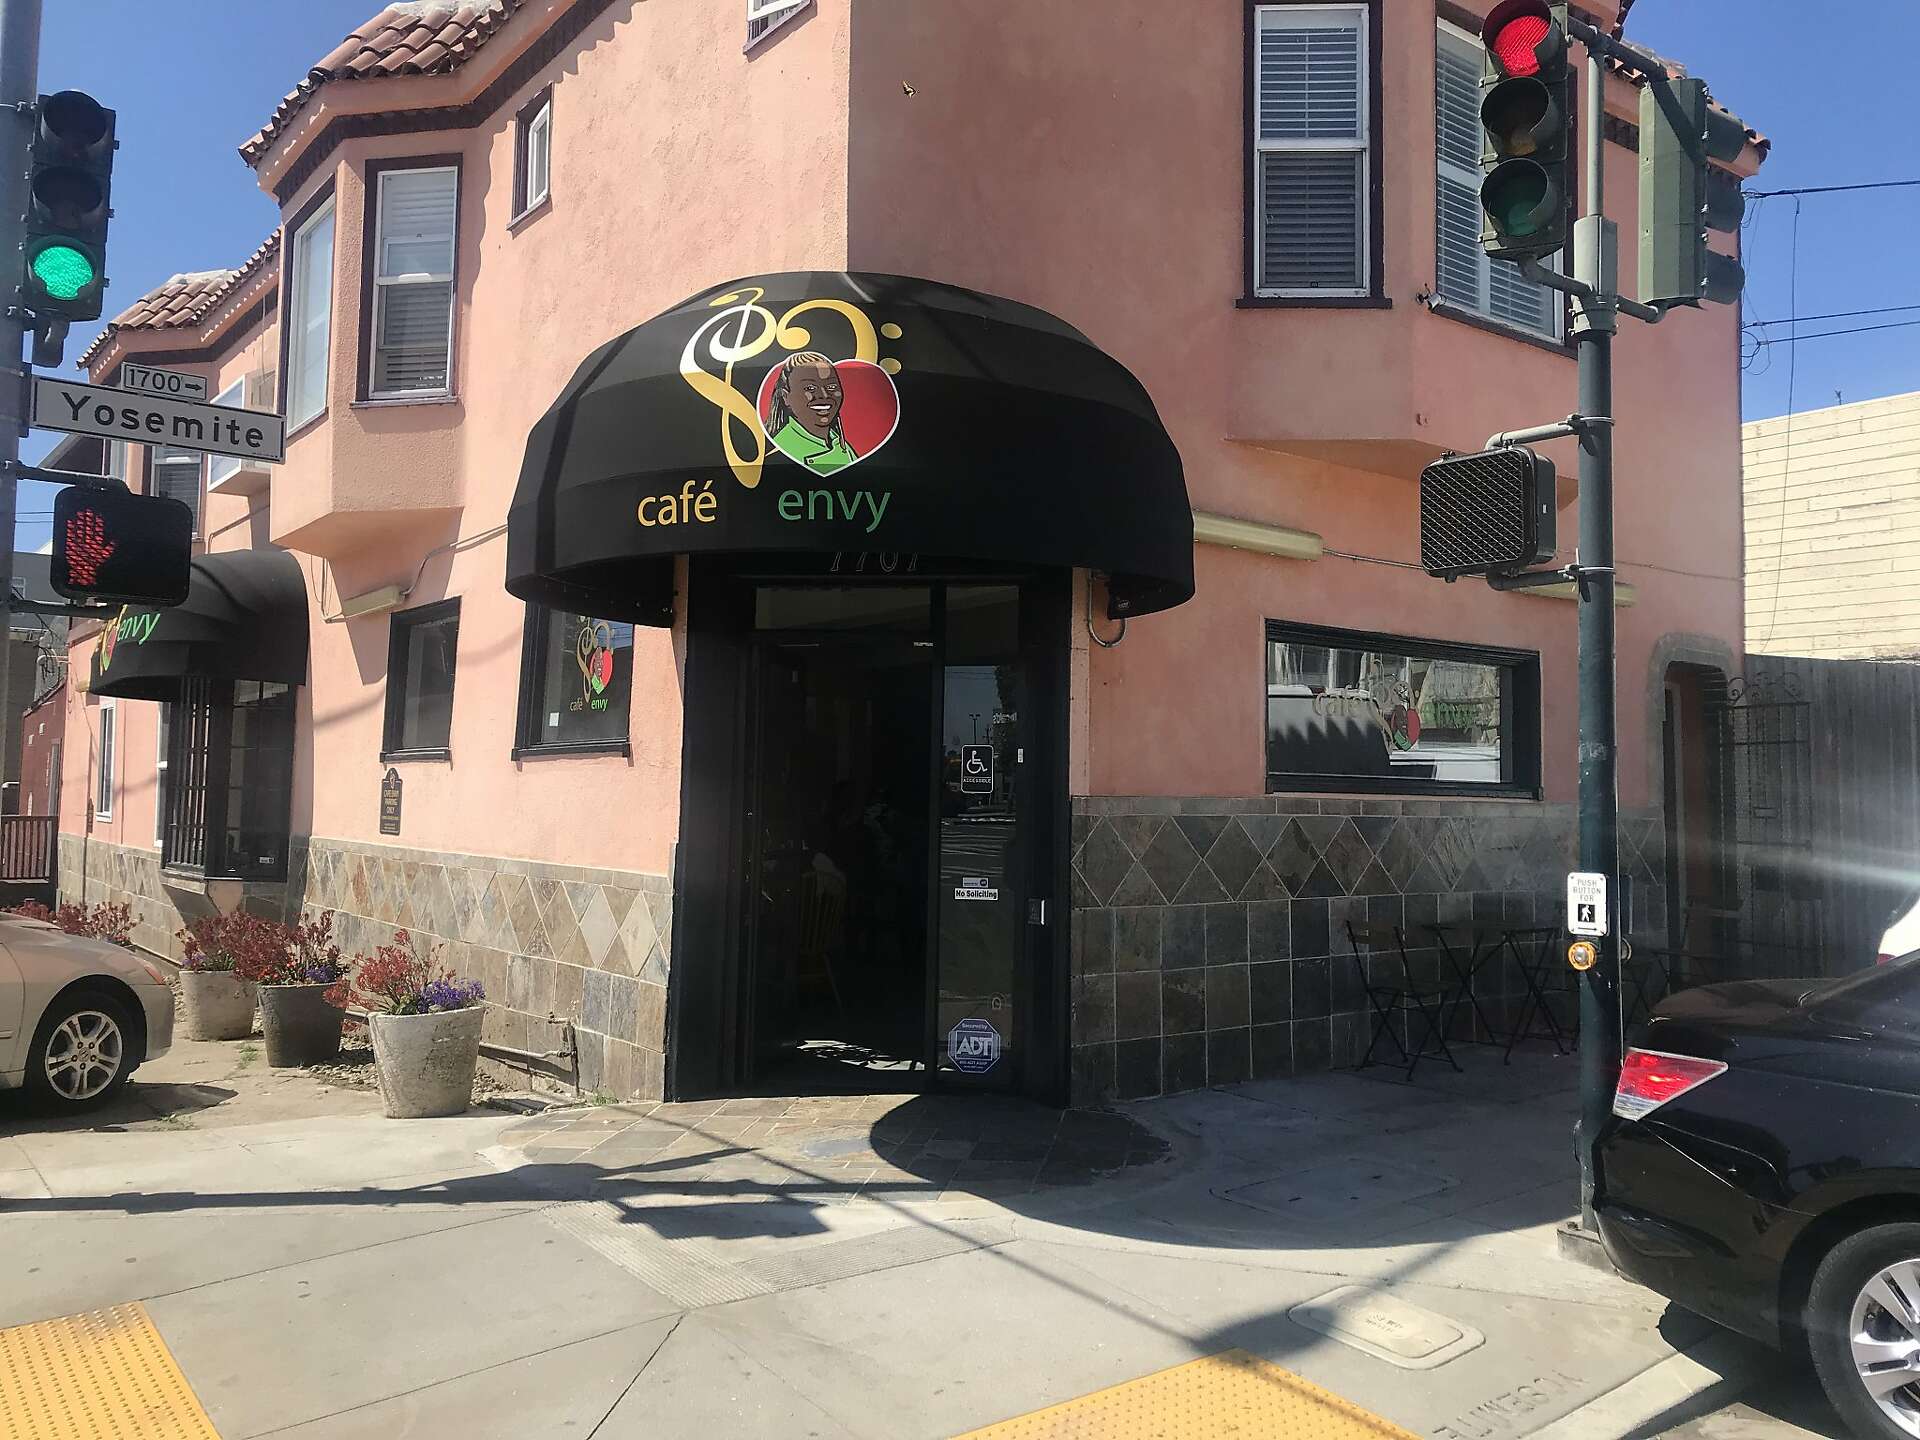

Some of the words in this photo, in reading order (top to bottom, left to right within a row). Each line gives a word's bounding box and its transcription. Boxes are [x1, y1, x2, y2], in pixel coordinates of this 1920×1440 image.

[128, 369, 181, 393] 1700
[61, 391, 264, 448] Yosemite
[637, 479, 717, 527] café
[777, 489, 892, 534] envy
[117, 613, 161, 645] envy
[591, 698, 609, 712] envy
[956, 889, 965, 897] No
[966, 890, 997, 899] Soliciting
[1577, 879, 1597, 887] PUSH
[956, 1035, 992, 1056] ADT
